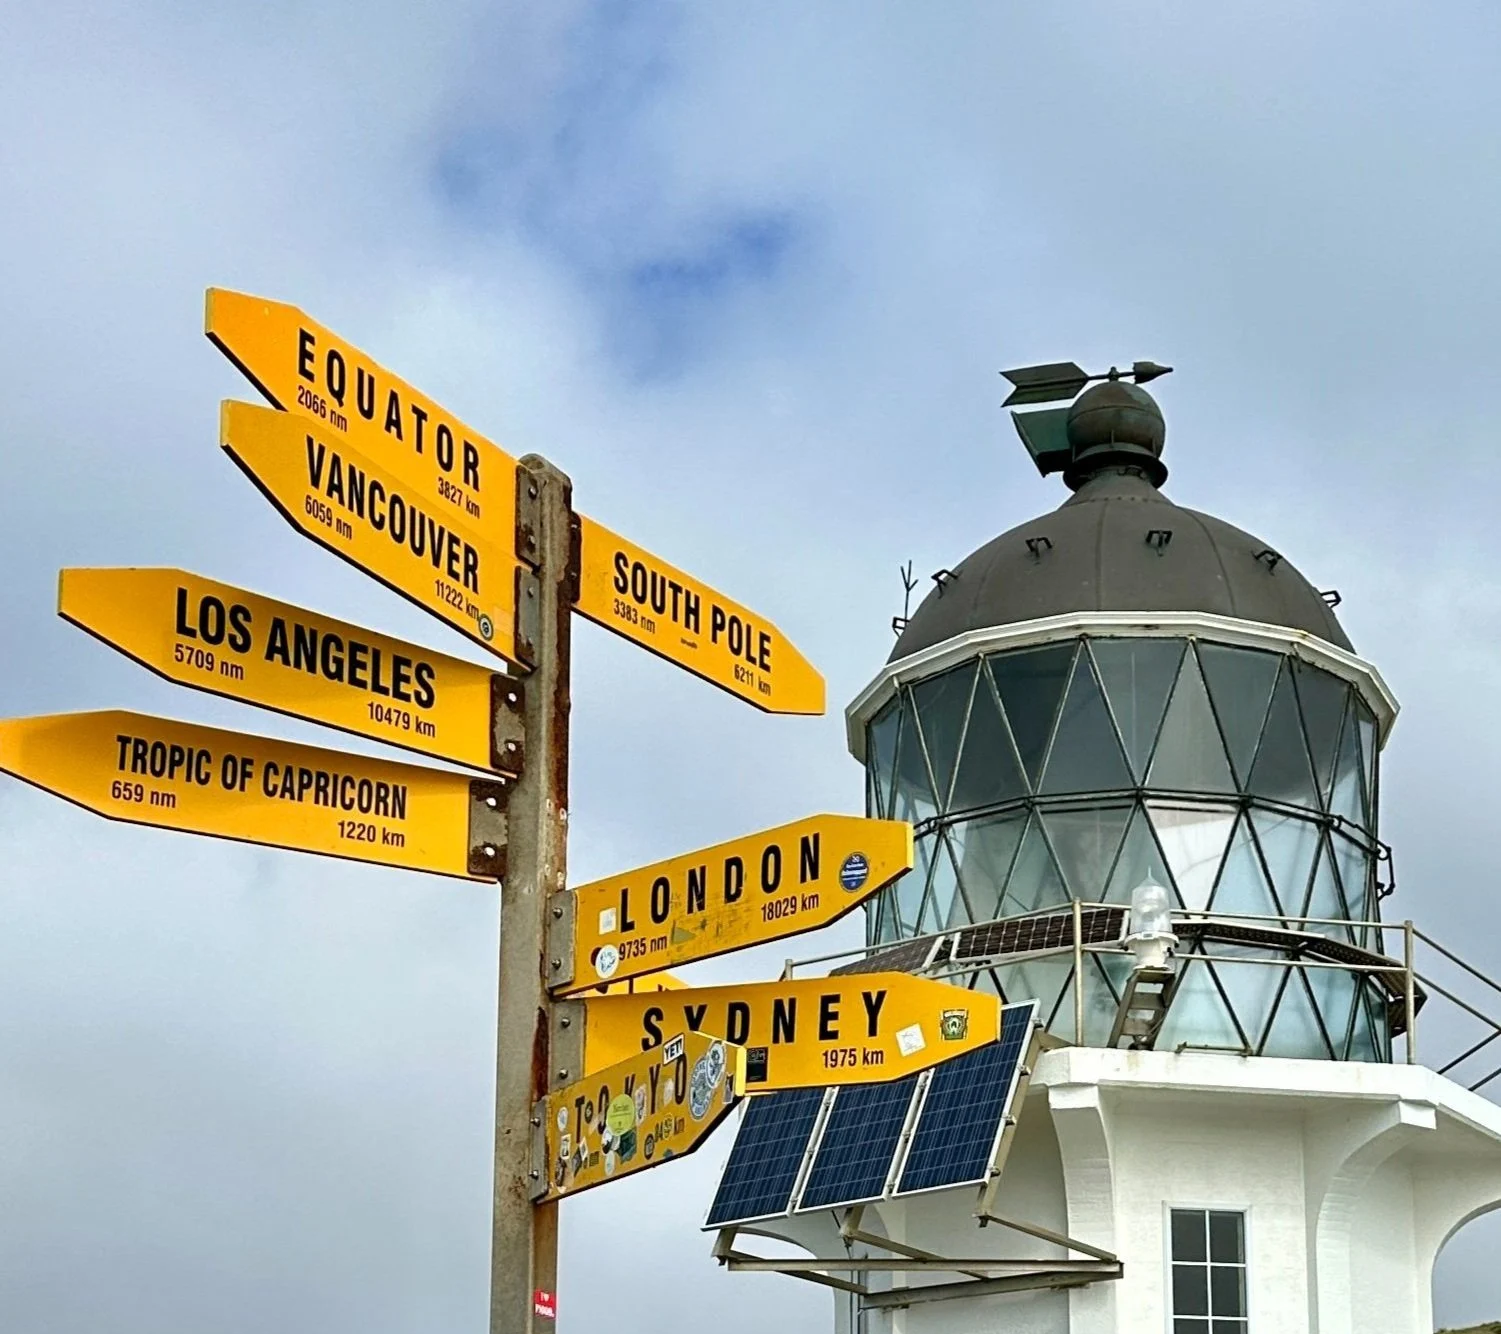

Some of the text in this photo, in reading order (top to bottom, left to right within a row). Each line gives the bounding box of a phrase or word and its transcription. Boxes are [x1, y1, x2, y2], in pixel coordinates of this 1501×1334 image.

[297, 384, 348, 433] 2066 nm
[298, 327, 481, 493] EQUATOR
[304, 494, 352, 541] 6059 nm
[305, 434, 480, 595] VANCOUVER
[437, 476, 481, 520] 3827 km
[434, 578, 480, 621] 11222 km
[613, 551, 771, 673] SOUTH POLE
[613, 598, 656, 634] 3383 nm
[174, 643, 244, 681] 5709 nm
[176, 586, 436, 709] LOS ANGELES
[734, 663, 771, 696] 6211 km
[367, 701, 436, 738] 10479 km
[112, 780, 176, 809] 659 nm
[116, 734, 407, 821] TROPIC OF CAPRICORN
[337, 820, 405, 848] 1220 km
[619, 832, 820, 932] LONDON
[760, 892, 820, 923] 18029 km
[619, 937, 647, 961] 9735
[650, 935, 667, 953] nm
[642, 990, 887, 1052] SYDNEY
[822, 1048, 884, 1068] 1975 km
